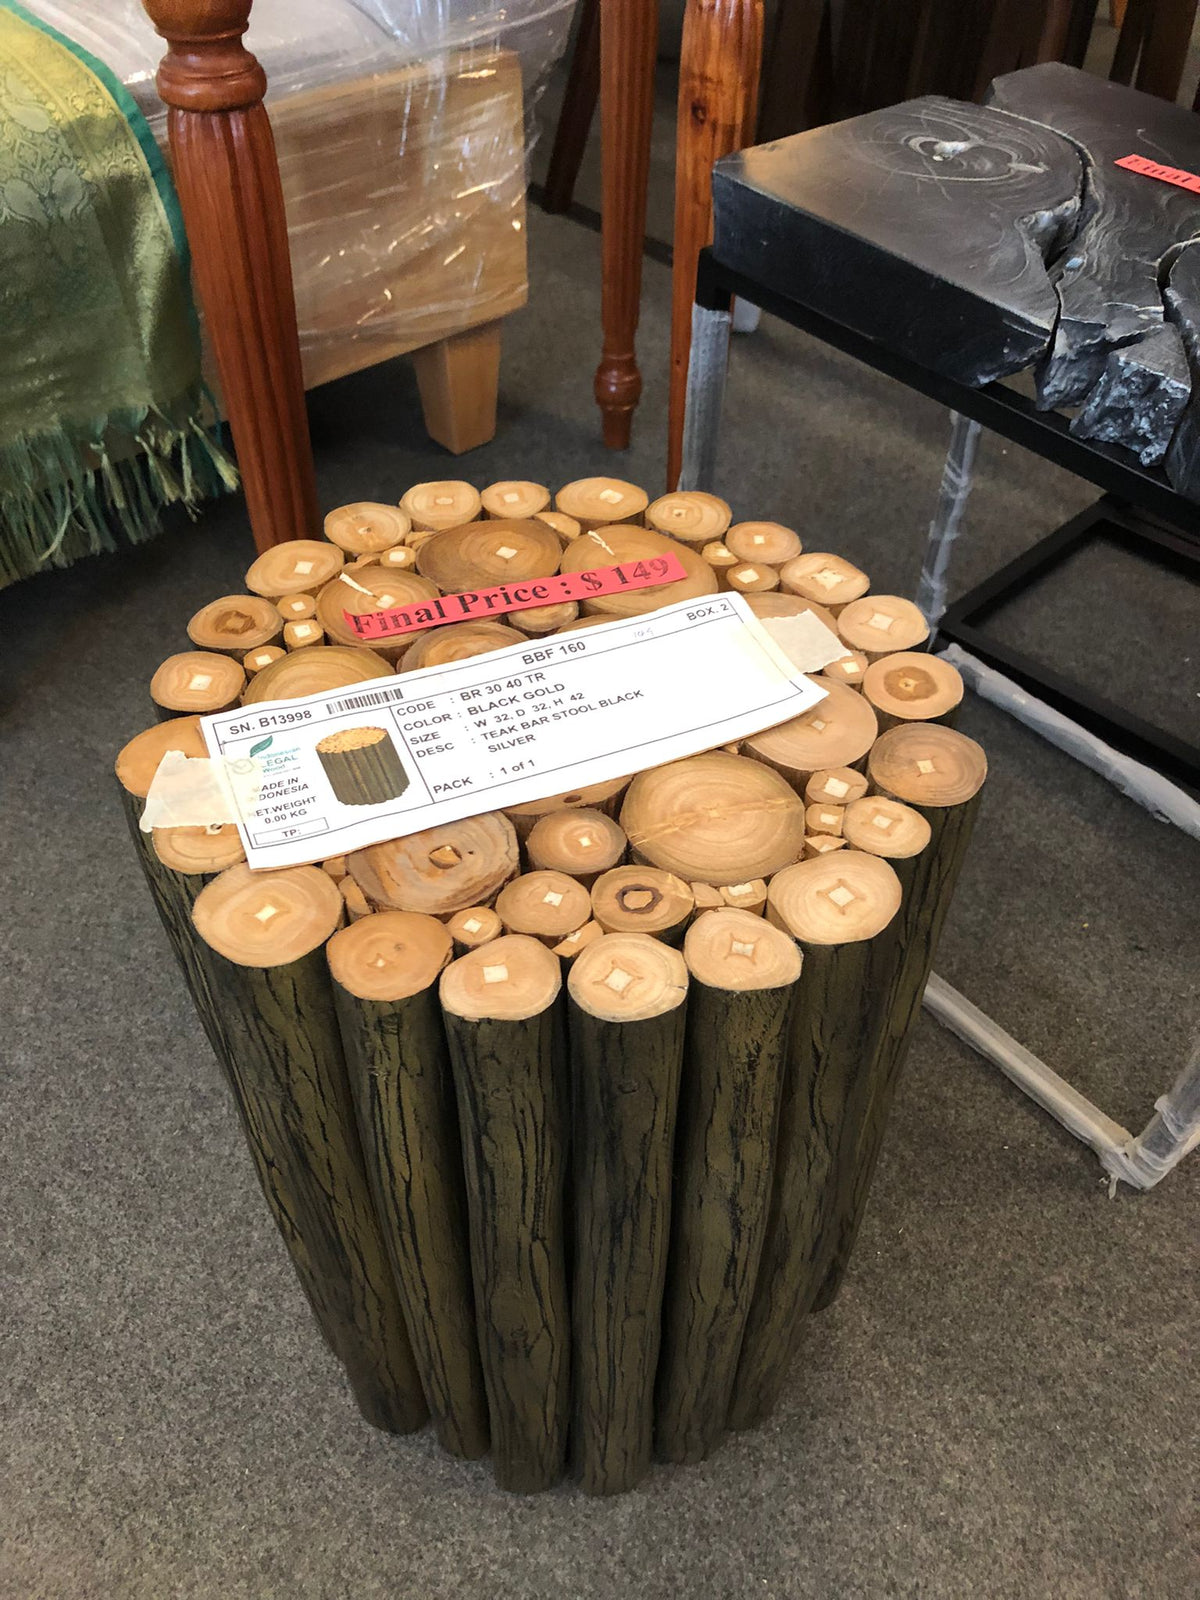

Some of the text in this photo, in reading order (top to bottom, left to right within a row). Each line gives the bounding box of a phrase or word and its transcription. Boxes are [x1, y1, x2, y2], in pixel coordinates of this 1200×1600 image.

[351, 557, 670, 634] Final Price : $ 149
[686, 603, 730, 621] BOX. 2
[521, 641, 586, 665] BBF 160
[396, 701, 436, 717] CODE
[460, 689, 483, 702] BR
[485, 684, 503, 695] 30
[506, 678, 523, 690] 40
[524, 672, 547, 685] TR
[403, 713, 453, 731] COLOR
[467, 695, 521, 716] BLACK
[523, 683, 566, 700] GOLD
[229, 710, 313, 736] SN. B13998
[410, 731, 441, 745] SIZE
[474, 719, 488, 729] W
[515, 708, 527, 718] D
[554, 698, 564, 707] H
[570, 692, 585, 702] 42
[416, 742, 455, 758] DESC
[481, 725, 519, 741] TEAK
[520, 716, 551, 730] BAR
[553, 703, 598, 721] STOOL
[598, 690, 644, 708] BLACK
[488, 733, 536, 753] SILVER
[288, 777, 299, 786] IN
[433, 776, 473, 794] PACK
[500, 766, 508, 775] 1
[511, 761, 524, 772] of
[529, 759, 536, 767] 1
[248, 783, 309, 801] DONESIA
[264, 808, 308, 824] 0.00 KG
